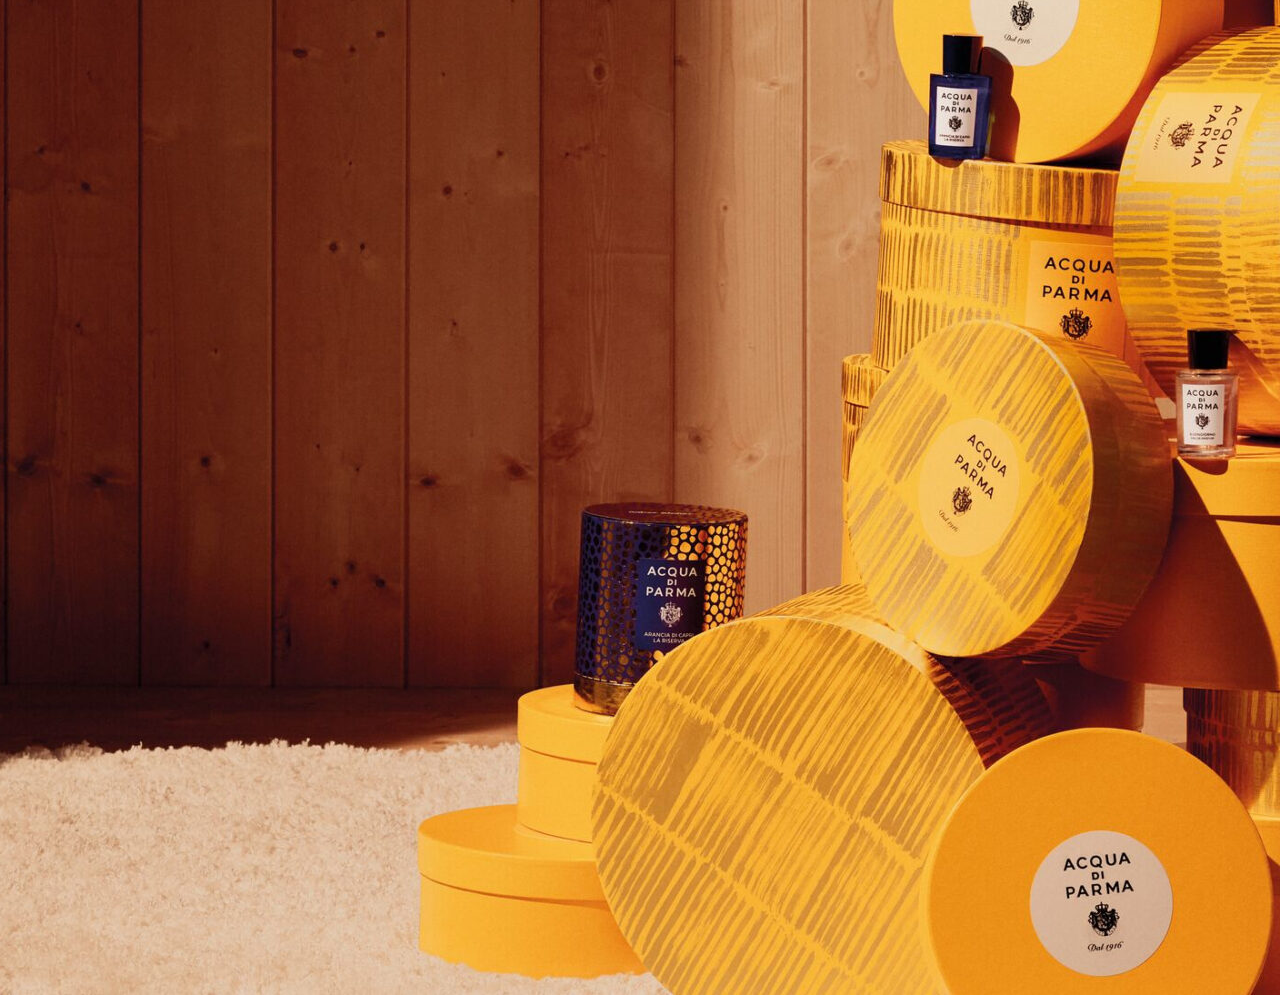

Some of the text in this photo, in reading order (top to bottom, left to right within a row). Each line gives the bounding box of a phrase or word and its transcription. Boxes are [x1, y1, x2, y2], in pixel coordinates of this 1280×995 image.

[941, 92, 972, 101] ACQUA
[940, 105, 971, 114] PARMA
[1191, 105, 1223, 167] PARMA
[1211, 128, 1221, 141] DI
[1212, 105, 1243, 168] ACQUA
[1044, 256, 1114, 274] ACQUA
[1072, 275, 1085, 285] DI
[1042, 285, 1112, 302] PARMA
[1186, 389, 1219, 397] ACQUA
[967, 434, 1007, 477] ACQUA
[976, 460, 986, 472] DI
[954, 454, 994, 500] PARMA
[647, 566, 698, 578] ACQUA
[646, 586, 697, 598] PARMA
[1063, 852, 1131, 871] ACQUA
[1091, 871, 1104, 880] DI
[1066, 880, 1134, 899] PARMA
[1087, 941, 1124, 952] Dal 1916
